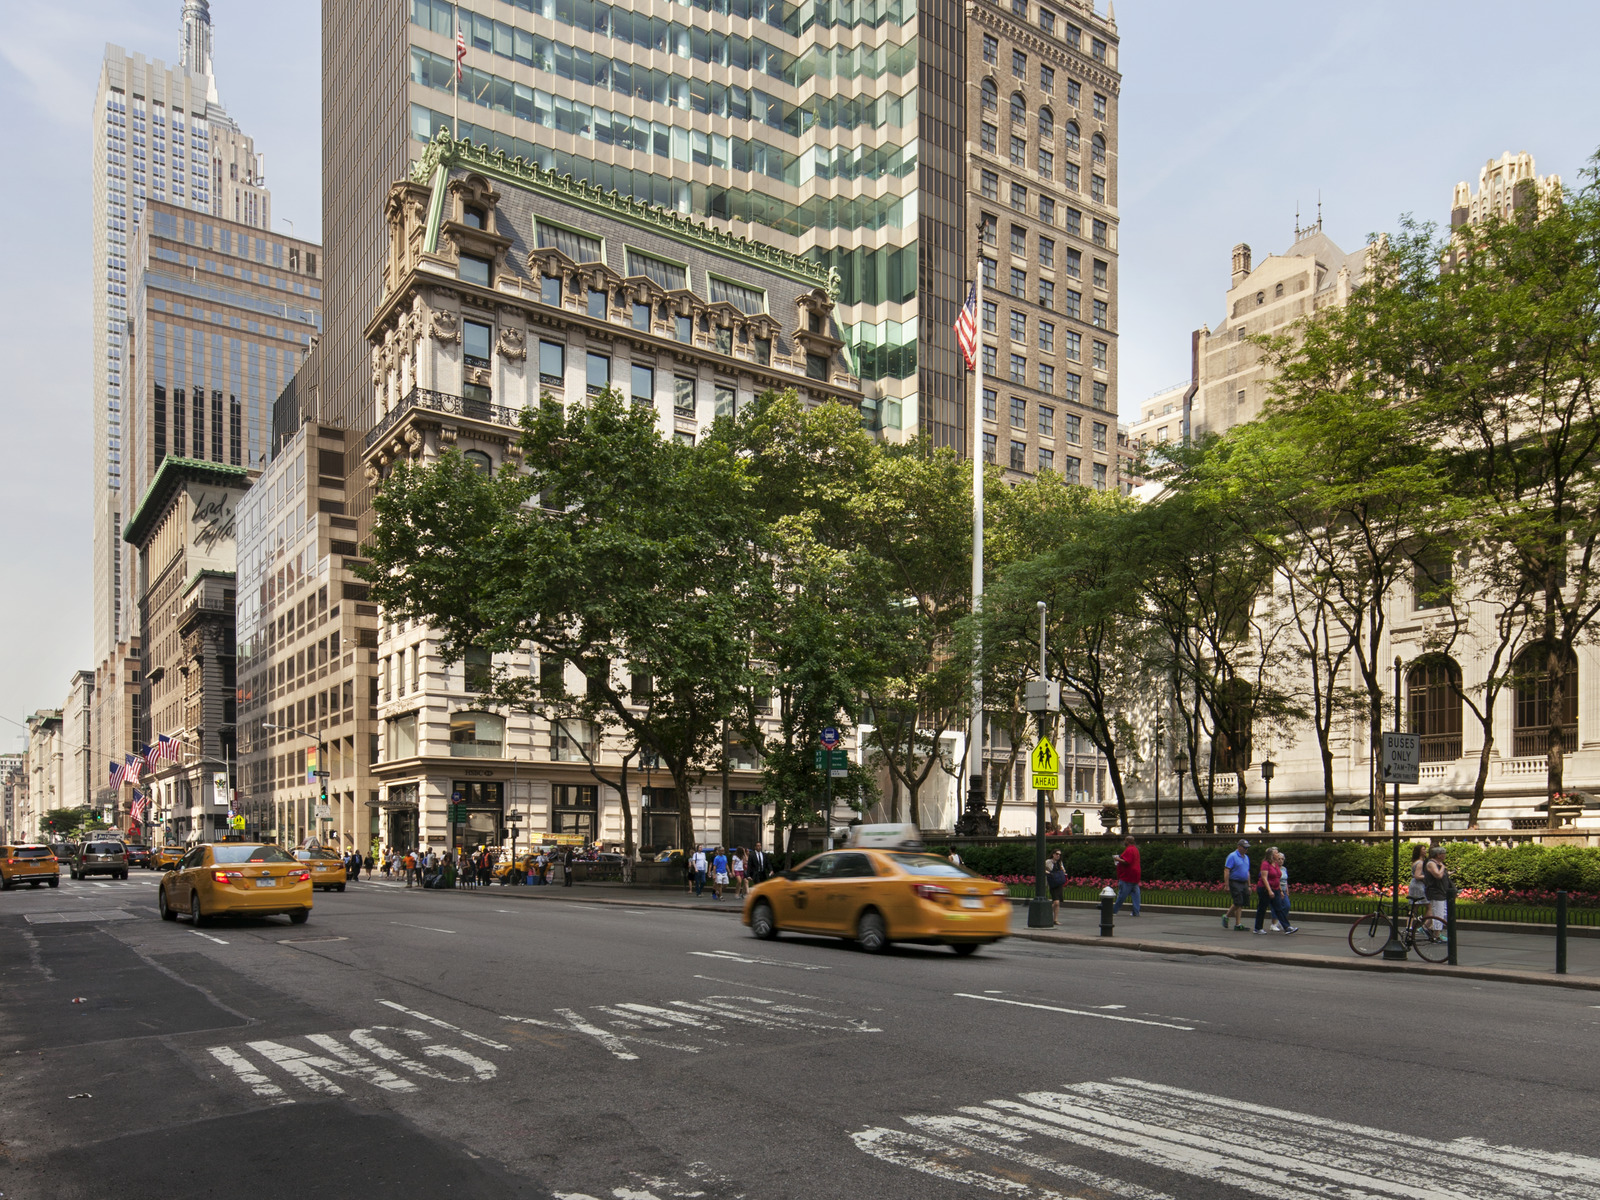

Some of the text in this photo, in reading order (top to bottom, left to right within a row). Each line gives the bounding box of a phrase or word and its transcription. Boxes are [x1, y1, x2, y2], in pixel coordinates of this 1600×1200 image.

[191, 492, 228, 521] Lord
[193, 513, 236, 554] Taylo
[1388, 737, 1415, 748] BUSES
[1391, 750, 1411, 762] ONLY
[1393, 762, 1417, 772] 7AM-7PM
[1034, 776, 1056, 787] AHEAD
